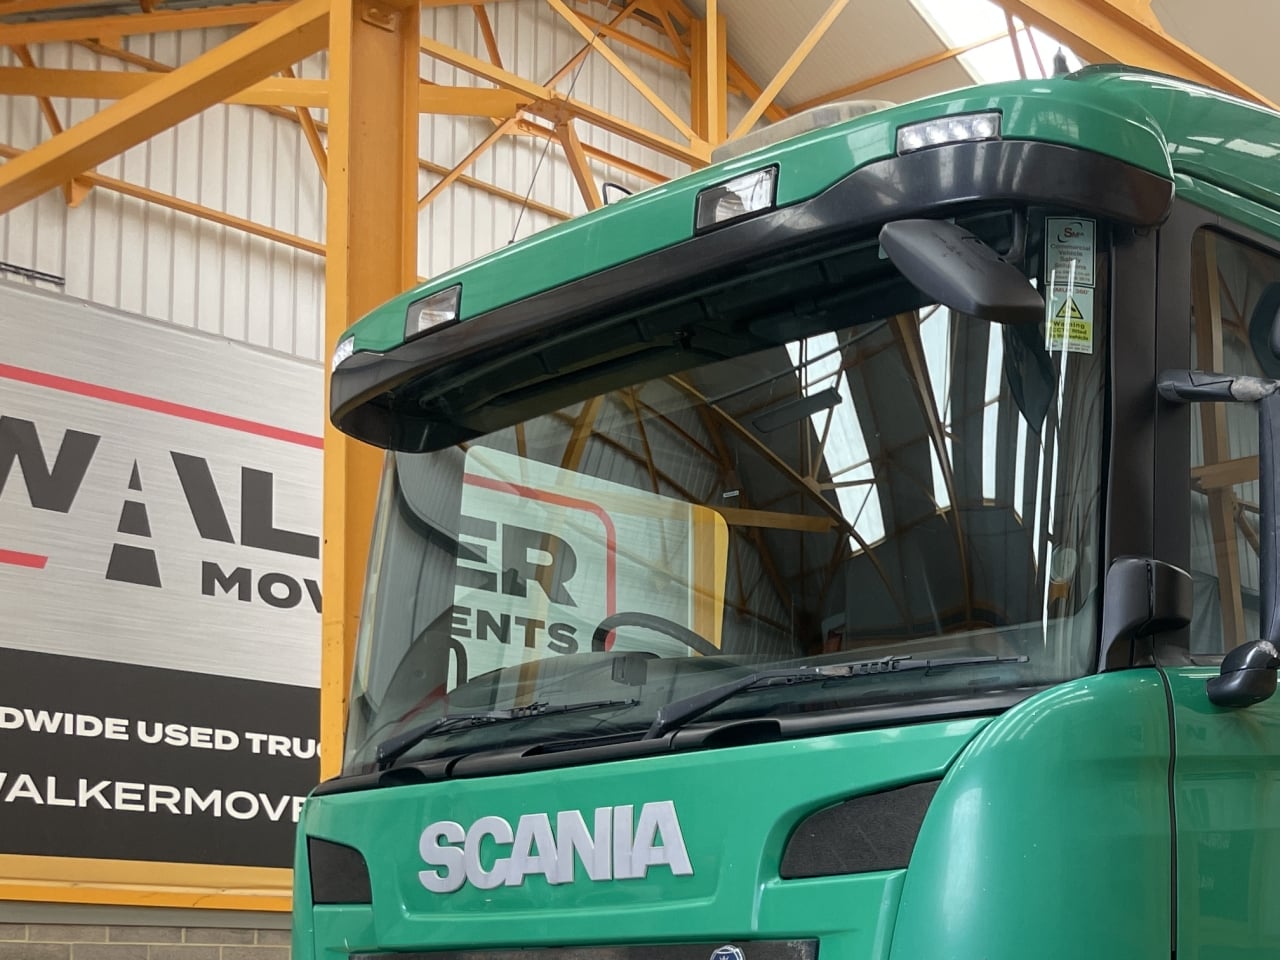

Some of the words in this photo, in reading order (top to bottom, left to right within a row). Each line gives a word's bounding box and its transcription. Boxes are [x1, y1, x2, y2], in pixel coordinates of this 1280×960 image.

[0, 706, 129, 741] DWIDE
[137, 721, 239, 751] USED
[245, 732, 321, 760] TRU
[418, 800, 694, 894] SCANIA
